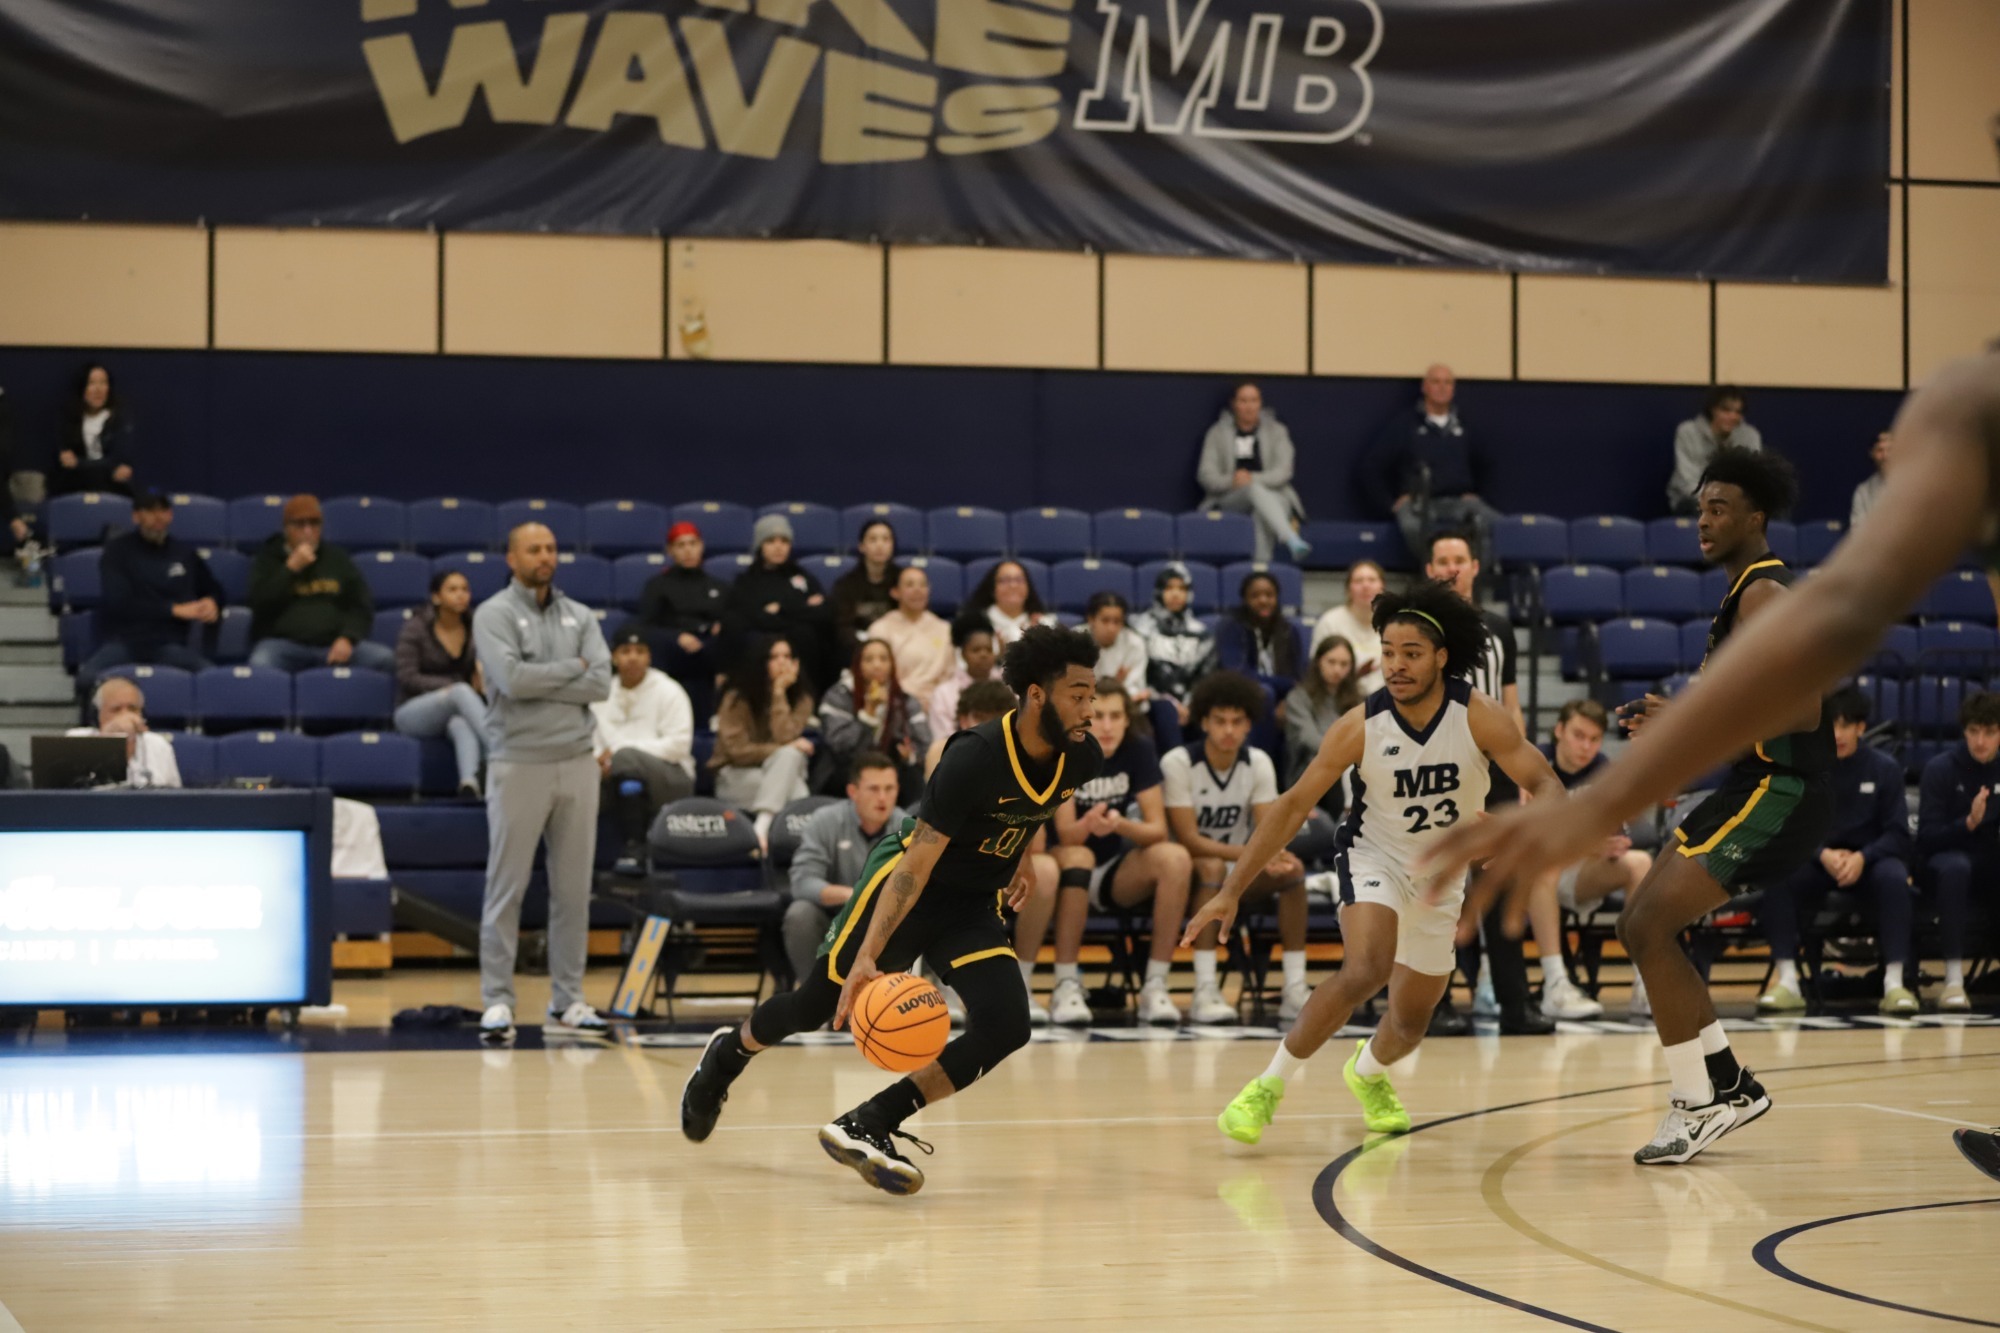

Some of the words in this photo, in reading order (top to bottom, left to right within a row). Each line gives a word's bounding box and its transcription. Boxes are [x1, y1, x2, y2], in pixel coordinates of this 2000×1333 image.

[361, 12, 1062, 163] WAVES
[1393, 762, 1460, 798] MB
[1197, 804, 1241, 829] MB
[1403, 798, 1460, 833] 23
